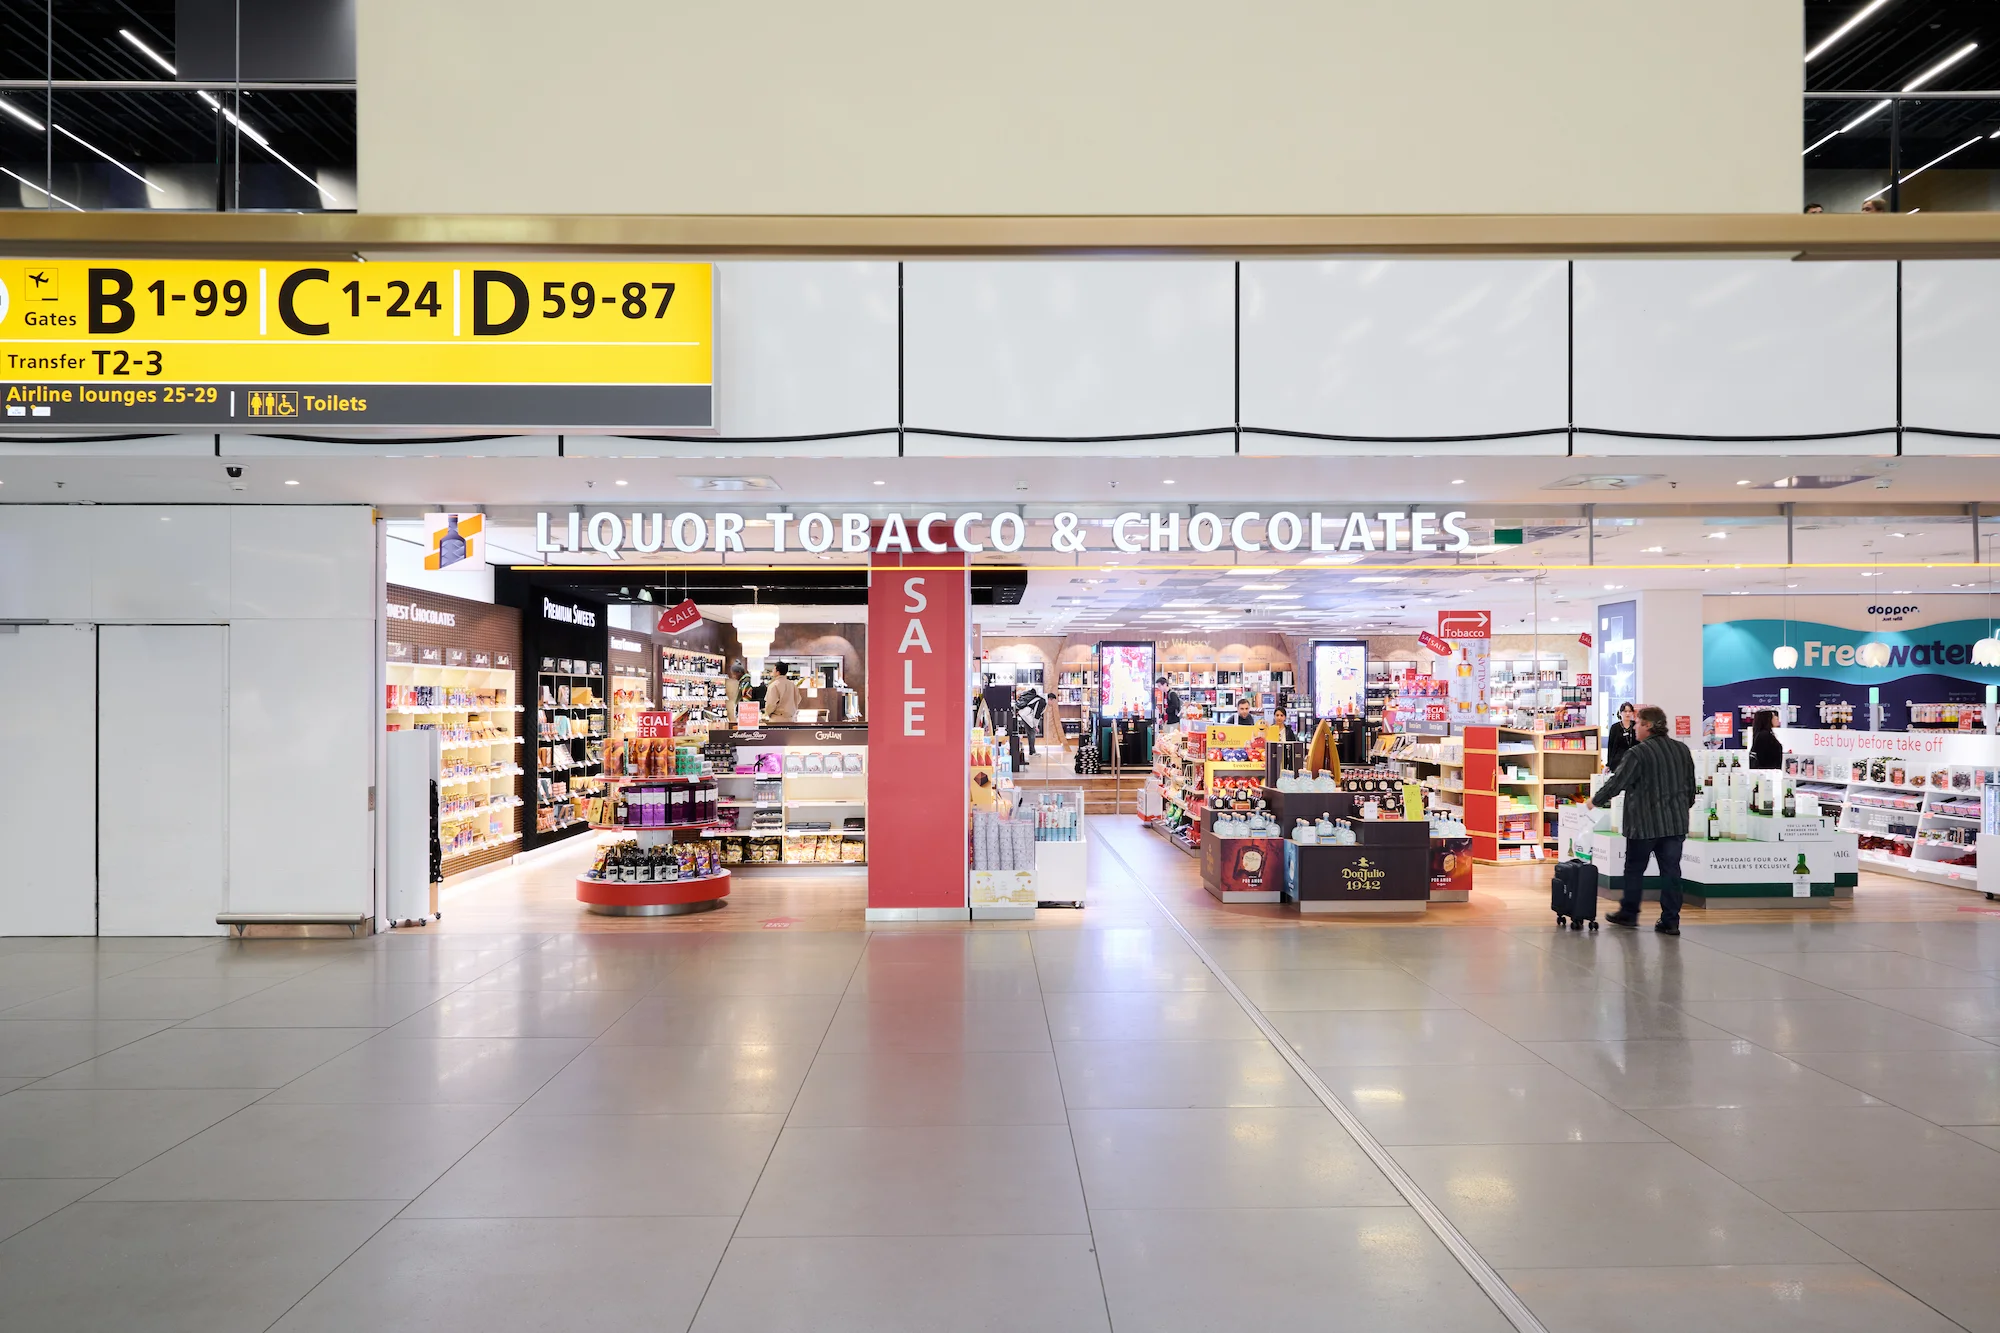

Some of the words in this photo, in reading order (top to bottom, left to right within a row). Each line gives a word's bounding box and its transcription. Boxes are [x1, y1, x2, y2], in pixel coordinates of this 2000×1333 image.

[88, 268, 136, 334] B
[147, 279, 248, 317] 1-99
[278, 267, 330, 336] C
[342, 280, 442, 317] 1-24
[473, 269, 530, 336] D
[542, 281, 676, 319] 59-87
[24, 311, 77, 327] Gates
[7, 353, 86, 369] Transfer
[92, 350, 163, 375] T2-3
[6, 386, 73, 403] Airline
[79, 386, 157, 406] lounges
[163, 386, 218, 403] 25-29
[303, 395, 367, 412] Toilets
[536, 511, 746, 561] LIQUOR
[766, 511, 1026, 553] TOBACCO
[1050, 511, 1087, 553] &
[1112, 511, 1470, 553] CHOCOLATES
[668, 606, 696, 627] SALE
[1445, 628, 1485, 638] Tobacco
[897, 577, 933, 737] SALE
[1429, 639, 1447, 653] SALE
[1814, 733, 1833, 747] Best
[1837, 733, 1855, 751] buy
[1858, 735, 1893, 750] before
[1897, 735, 1922, 751] take
[1925, 737, 1944, 753] off
[1346, 880, 1381, 890] 1942
